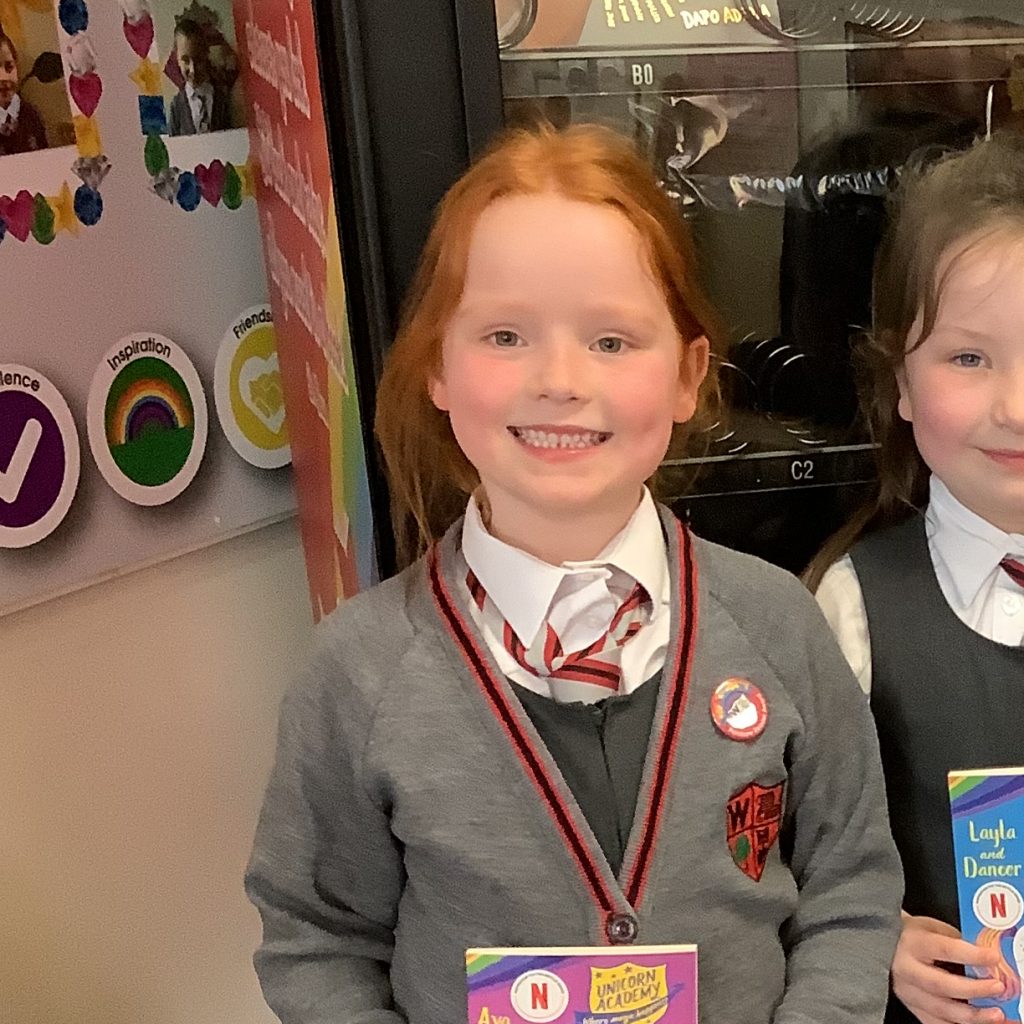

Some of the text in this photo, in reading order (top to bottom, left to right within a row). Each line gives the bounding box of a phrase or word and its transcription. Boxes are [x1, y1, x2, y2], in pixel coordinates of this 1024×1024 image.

[680, 10, 720, 29] DAPO
[232, 308, 274, 339] Friends
[106, 337, 172, 371] Inspiration
[791, 460, 814, 480] C2
[726, 798, 750, 832] W
[969, 818, 1016, 848] Layla
[963, 856, 1022, 879] Dancer
[980, 847, 1006, 860] and
[990, 892, 1007, 919] N
[531, 983, 549, 1010] N
[595, 982, 660, 1012] ACADEMY
[597, 969, 656, 998] UNICORN
